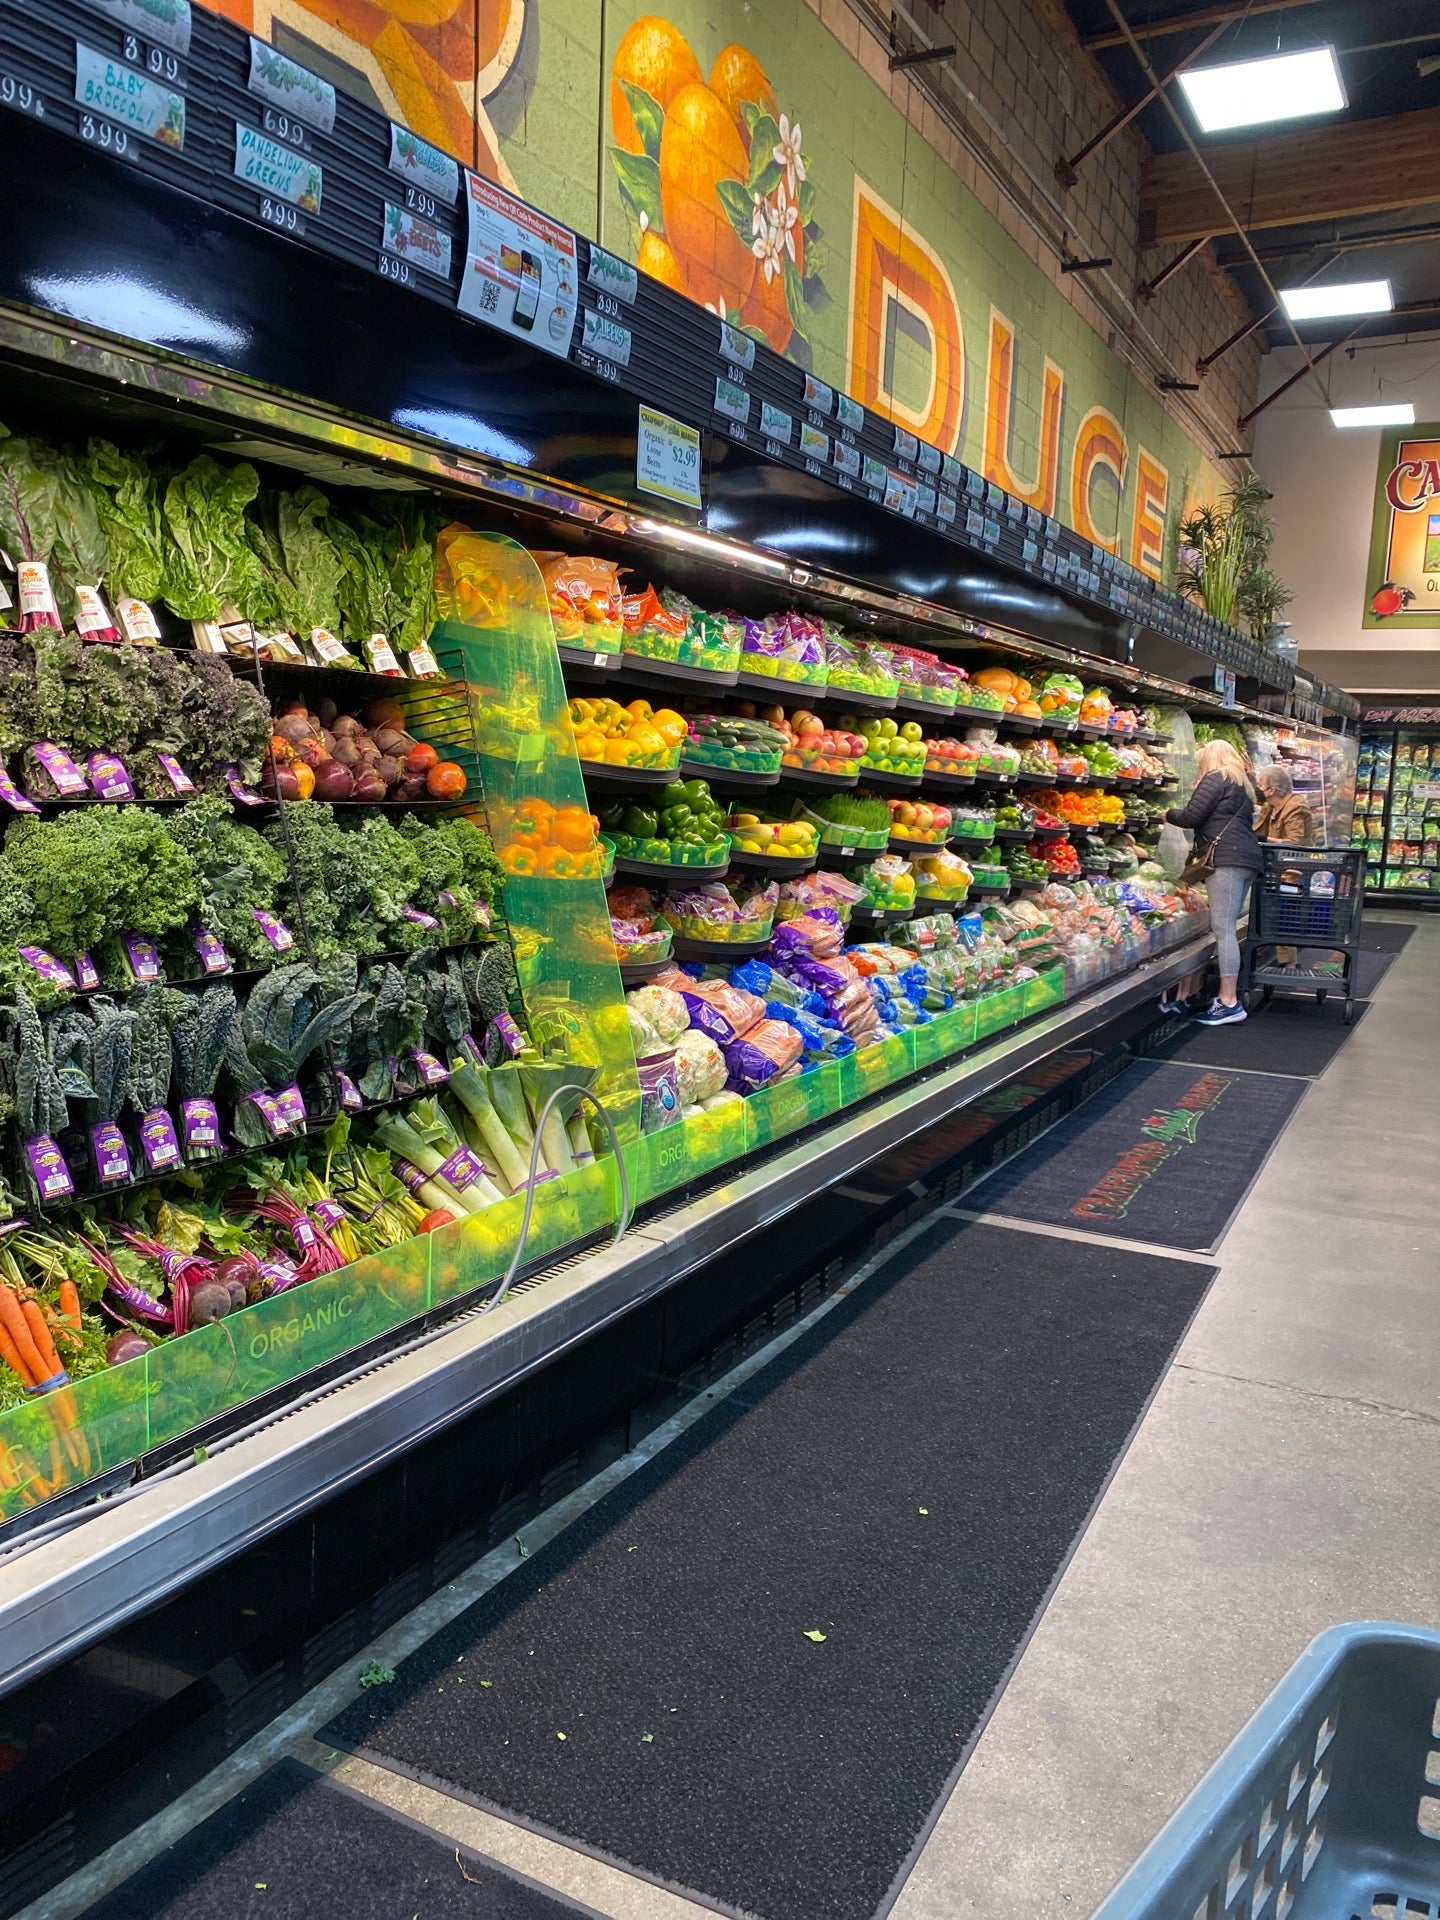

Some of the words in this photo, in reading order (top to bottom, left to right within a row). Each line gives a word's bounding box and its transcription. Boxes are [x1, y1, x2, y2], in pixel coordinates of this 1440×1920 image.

[104, 63, 147, 97] BABY
[84, 79, 156, 126] BROCCOLI
[240, 130, 304, 174] DANDELION
[244, 156, 292, 194] GREENS
[409, 227, 442, 258] BEETS
[600, 316, 624, 348] LEEKS
[644, 428, 665, 446] Organic
[646, 442, 662, 457] Loose
[646, 455, 661, 469] Beets
[672, 445, 697, 468] $2.99
[249, 1294, 352, 1359] ORGANIC
